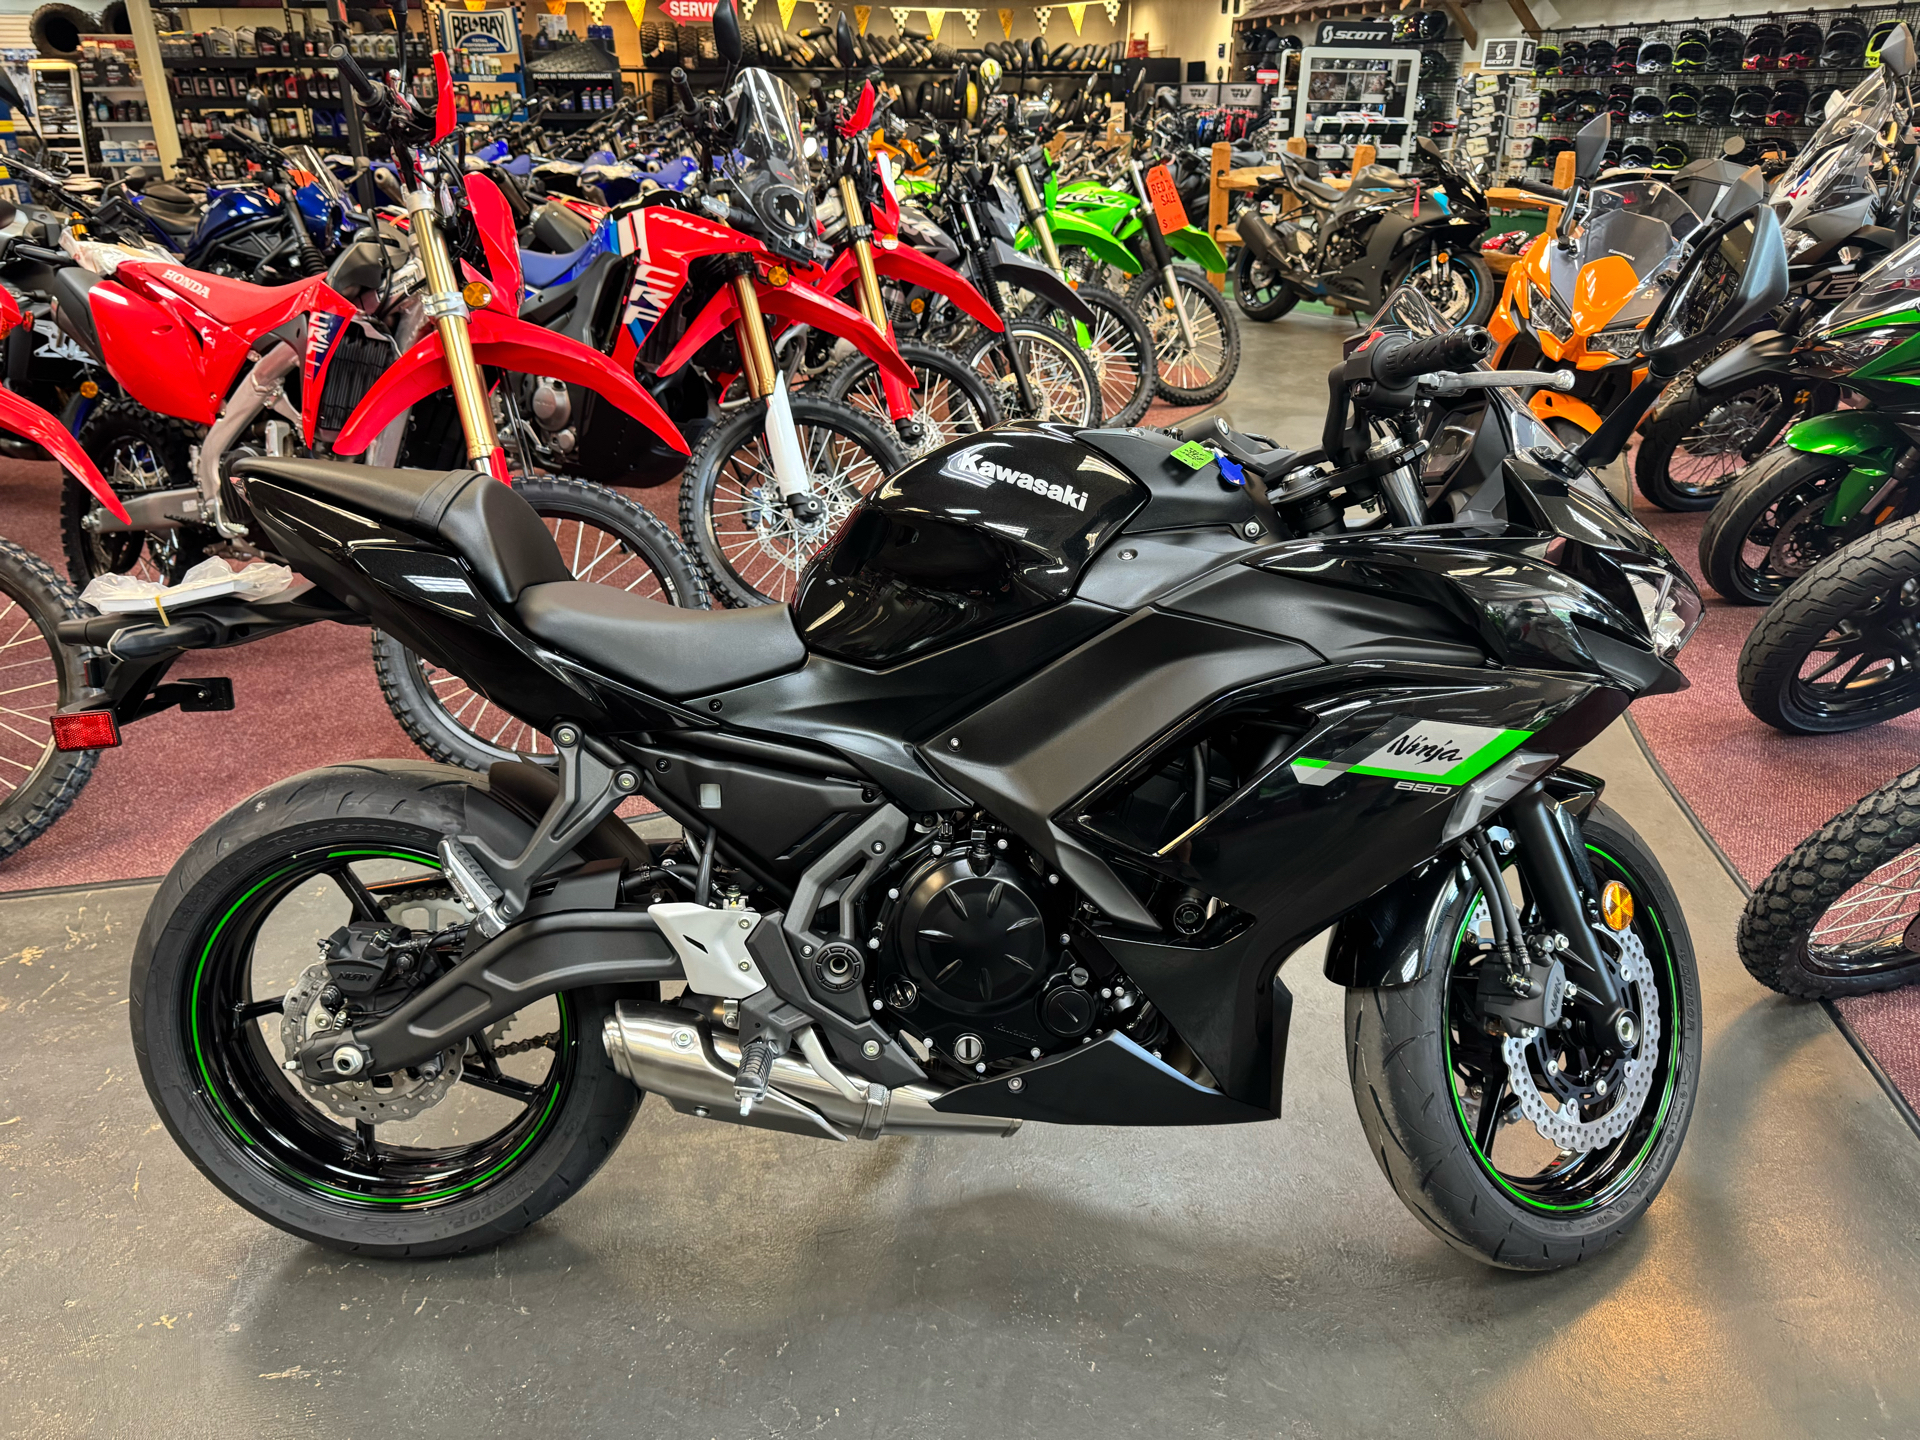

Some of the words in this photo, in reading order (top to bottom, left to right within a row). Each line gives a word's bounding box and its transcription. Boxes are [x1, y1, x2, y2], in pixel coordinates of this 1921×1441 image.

[669, 1, 718, 17] SERVI
[1333, 30, 1388, 41] SCOTT
[571, 72, 613, 80] PERFORMANCE
[1150, 181, 1166, 196] RED
[1160, 191, 1176, 206] SALE
[648, 212, 730, 239] RALLY
[161, 269, 211, 299] HONDA
[958, 452, 1089, 512] Kawasaki
[1386, 735, 1463, 765] Ninja
[1394, 781, 1452, 795] 650
